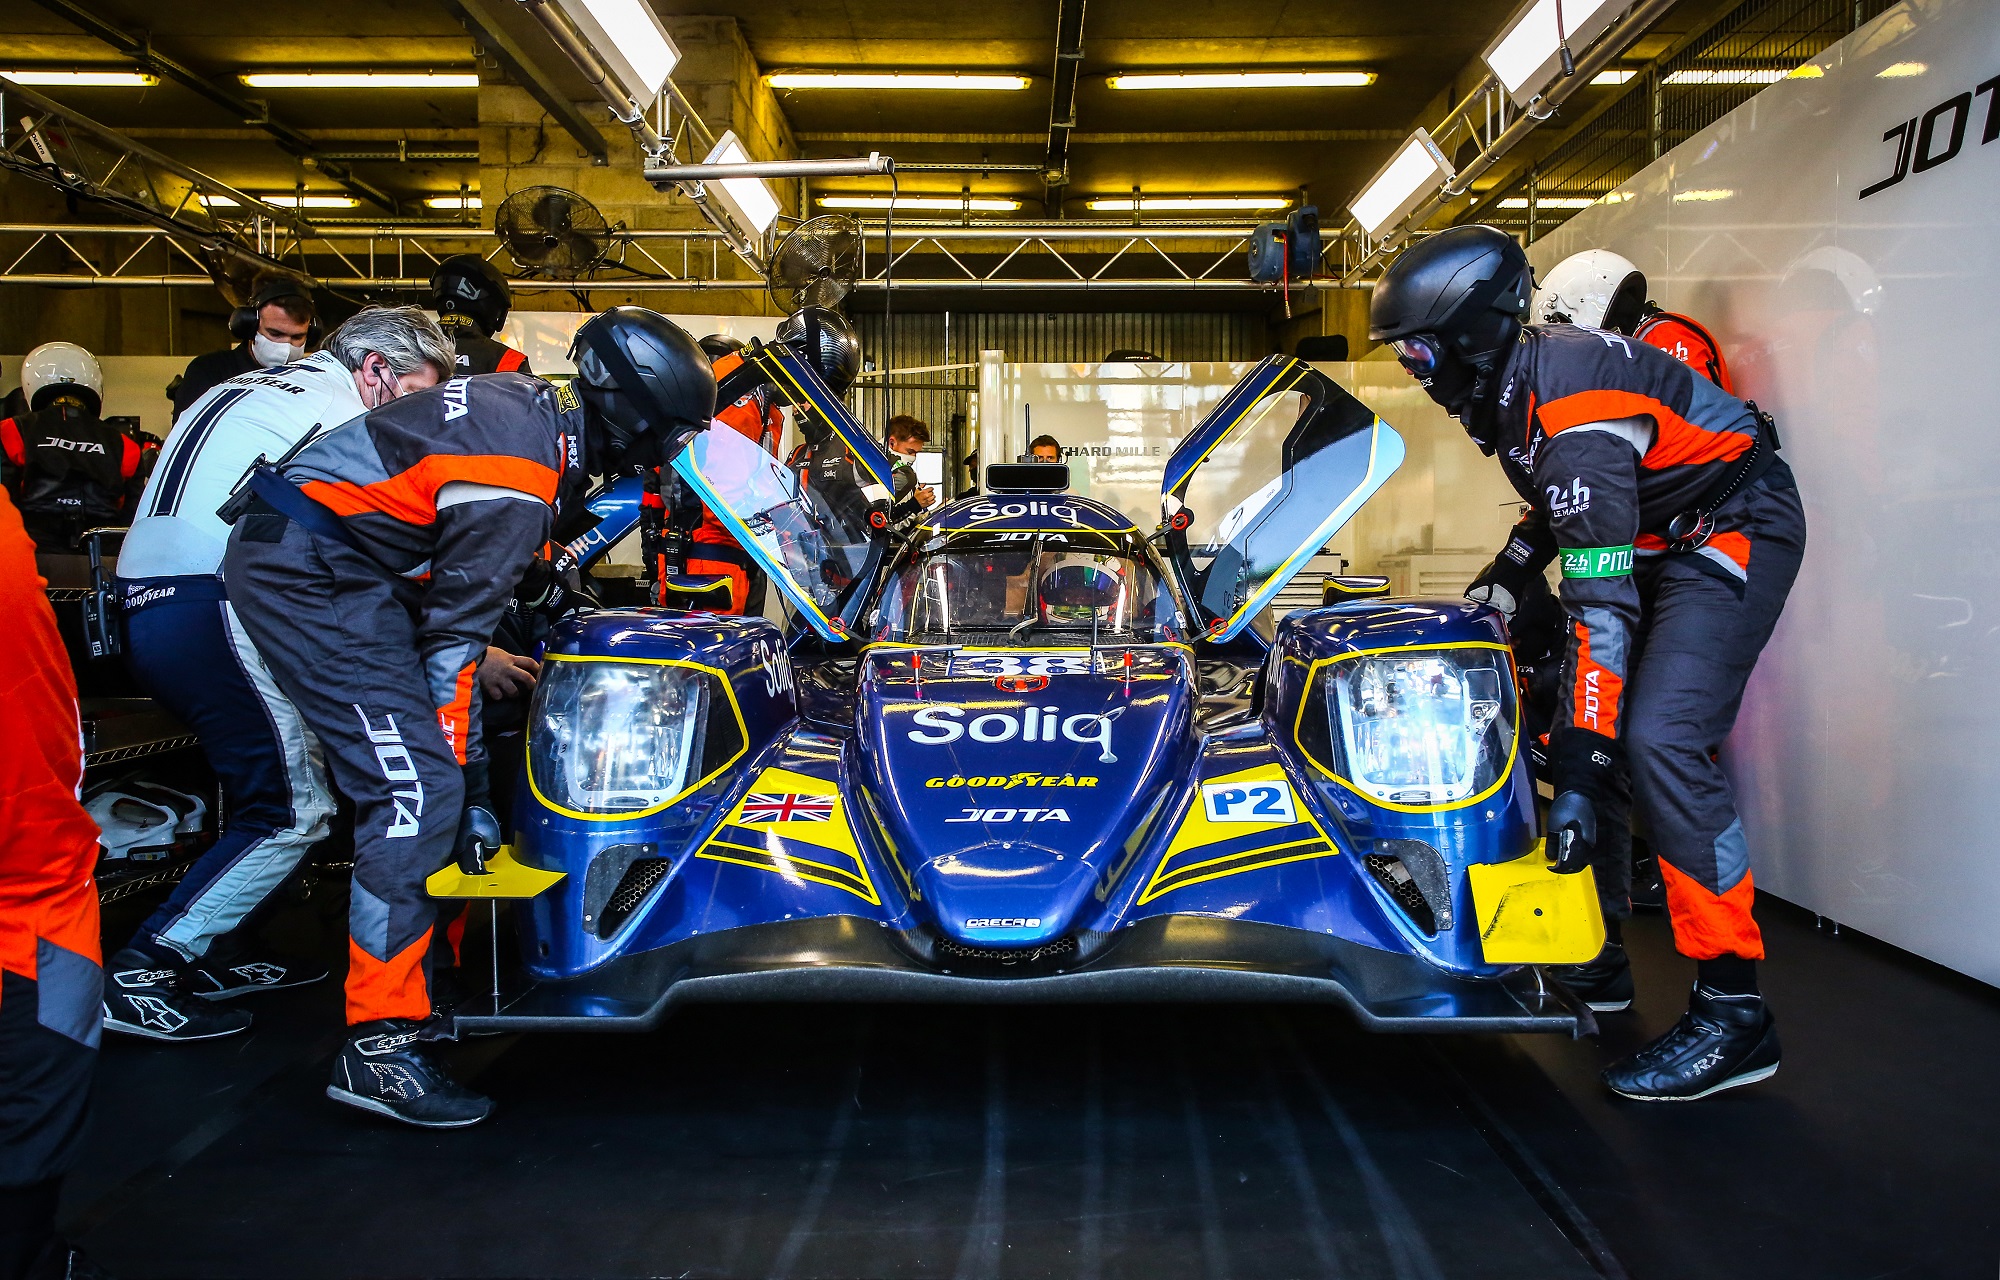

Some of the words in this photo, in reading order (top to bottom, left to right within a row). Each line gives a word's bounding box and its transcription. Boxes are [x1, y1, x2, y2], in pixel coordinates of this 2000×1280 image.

[37, 436, 106, 455] JOTA
[567, 435, 580, 469] HRX
[1115, 446, 1161, 457] MILLE
[1546, 476, 1591, 511] 24h
[968, 501, 1083, 529] Soliq
[983, 532, 1069, 543] JOTA
[122, 586, 176, 610] OODYEAR
[963, 656, 1084, 676] 38
[1584, 670, 1600, 730] JOTA
[908, 706, 1126, 763] Soliq
[353, 703, 424, 839] JOTA
[925, 772, 1099, 790] GOODYEAR
[1211, 786, 1287, 816] P2
[944, 808, 1071, 823] JOTA
[965, 918, 1026, 929] ORECA
